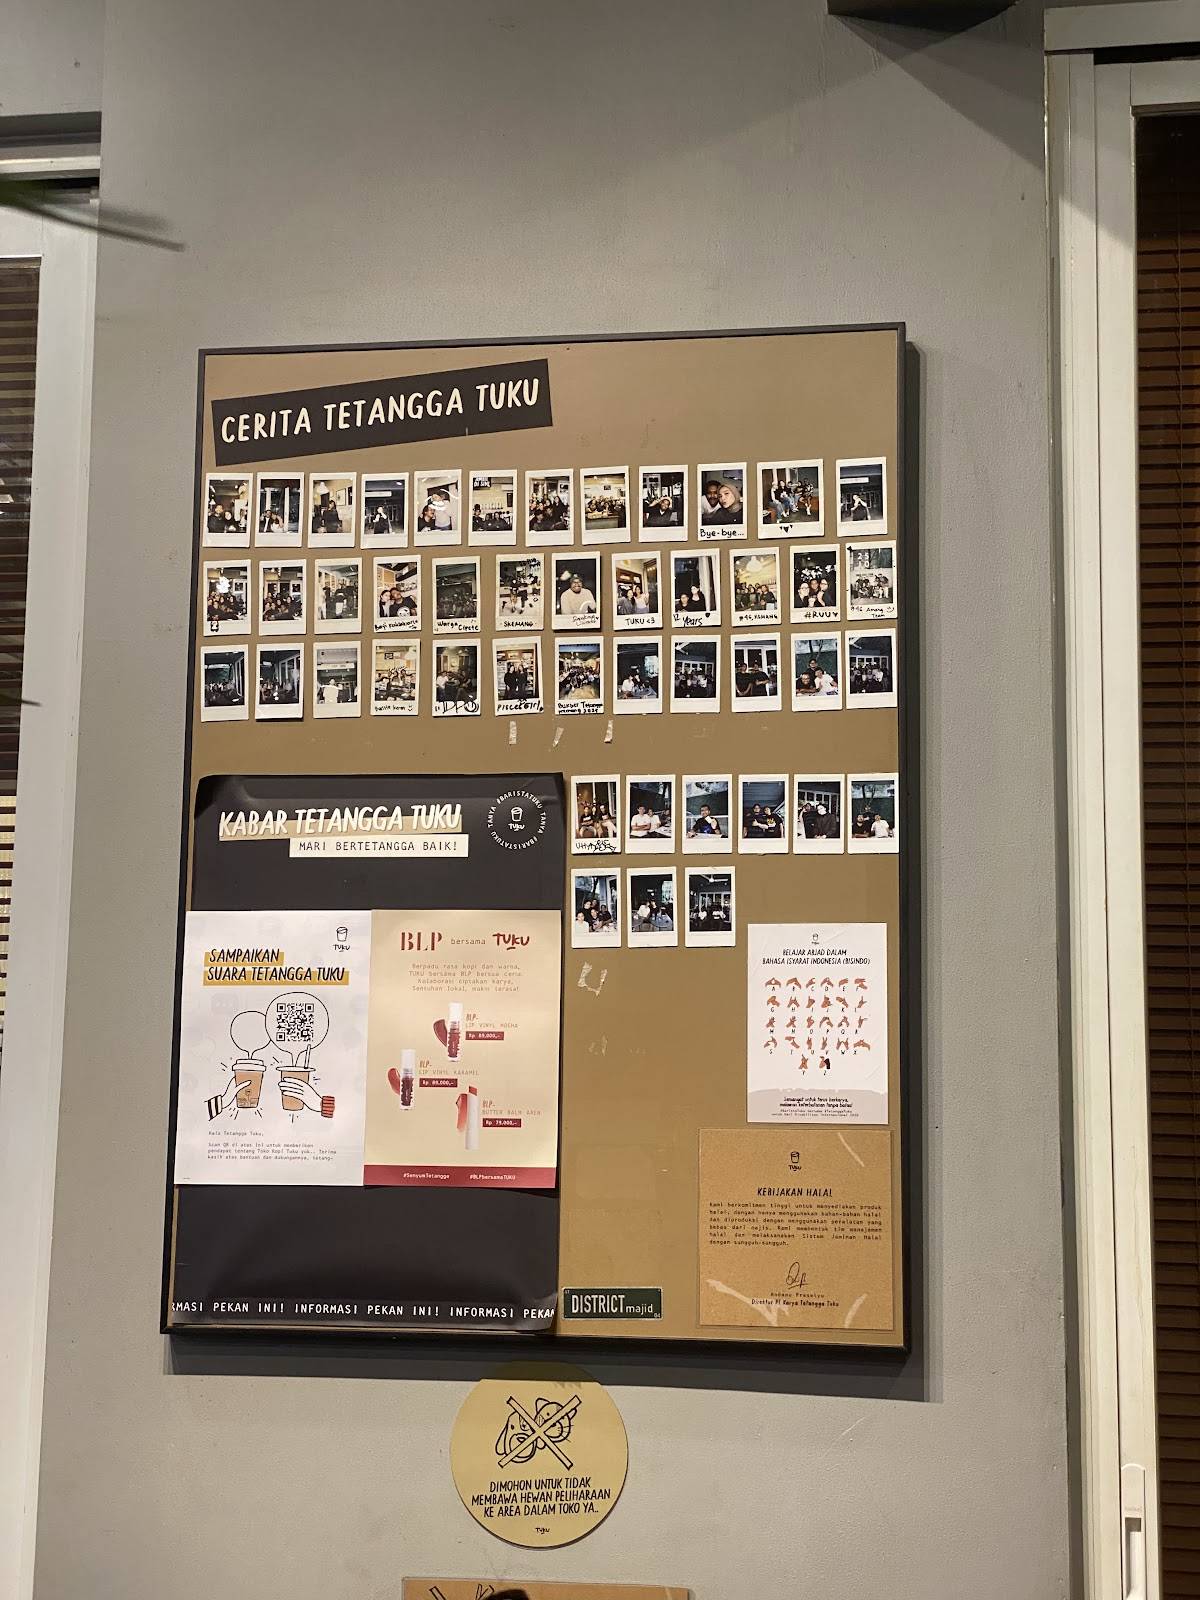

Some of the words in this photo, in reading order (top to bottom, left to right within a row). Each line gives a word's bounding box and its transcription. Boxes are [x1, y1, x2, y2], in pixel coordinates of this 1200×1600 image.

[221, 408, 311, 443] CERITA
[323, 387, 464, 431] TETANGGA
[475, 378, 540, 412] TUKU
[219, 809, 288, 837] KABAR
[294, 805, 403, 834] TETANGGA
[410, 803, 462, 831] TUKU
[299, 841, 327, 851] MARI
[335, 841, 415, 851] BERTETANGGA
[422, 840, 458, 851] BAIK!
[400, 931, 443, 951] BLP
[492, 932, 530, 951] TUKU
[209, 948, 280, 963] SAMPAIKAN
[762, 957, 785, 965] BAHASA
[786, 957, 809, 965] ISYARAT
[810, 957, 842, 965] INDONESIA
[207, 966, 247, 981] SUARA
[251, 966, 312, 981] TETANGGA
[316, 966, 345, 981] TUKU
[757, 1187, 803, 1197] KEBIJAKAN
[806, 1187, 833, 1198] HALAL
[213, 1302, 249, 1313] PEKAN
[258, 1303, 285, 1313] INI!
[294, 1303, 358, 1314] INFORMASI
[367, 1305, 403, 1316] PEKAN
[413, 1306, 439, 1316] INI!
[450, 1306, 514, 1318] INFORMASI
[571, 1294, 625, 1314] DISTRICT
[625, 1303, 653, 1316] majid
[490, 1480, 532, 1493] DIMOHON
[534, 1478, 563, 1490] UNTUK
[564, 1476, 592, 1489] TIDAK
[471, 1493, 518, 1506] MEMBAWA
[520, 1491, 553, 1504] HEWAN
[555, 1488, 611, 1502] PELIHARAAN
[483, 1506, 494, 1518] KE
[497, 1505, 521, 1517] AREA
[524, 1503, 556, 1516] DALAM
[558, 1502, 581, 1515] TOKO
[582, 1501, 599, 1514] YA..
